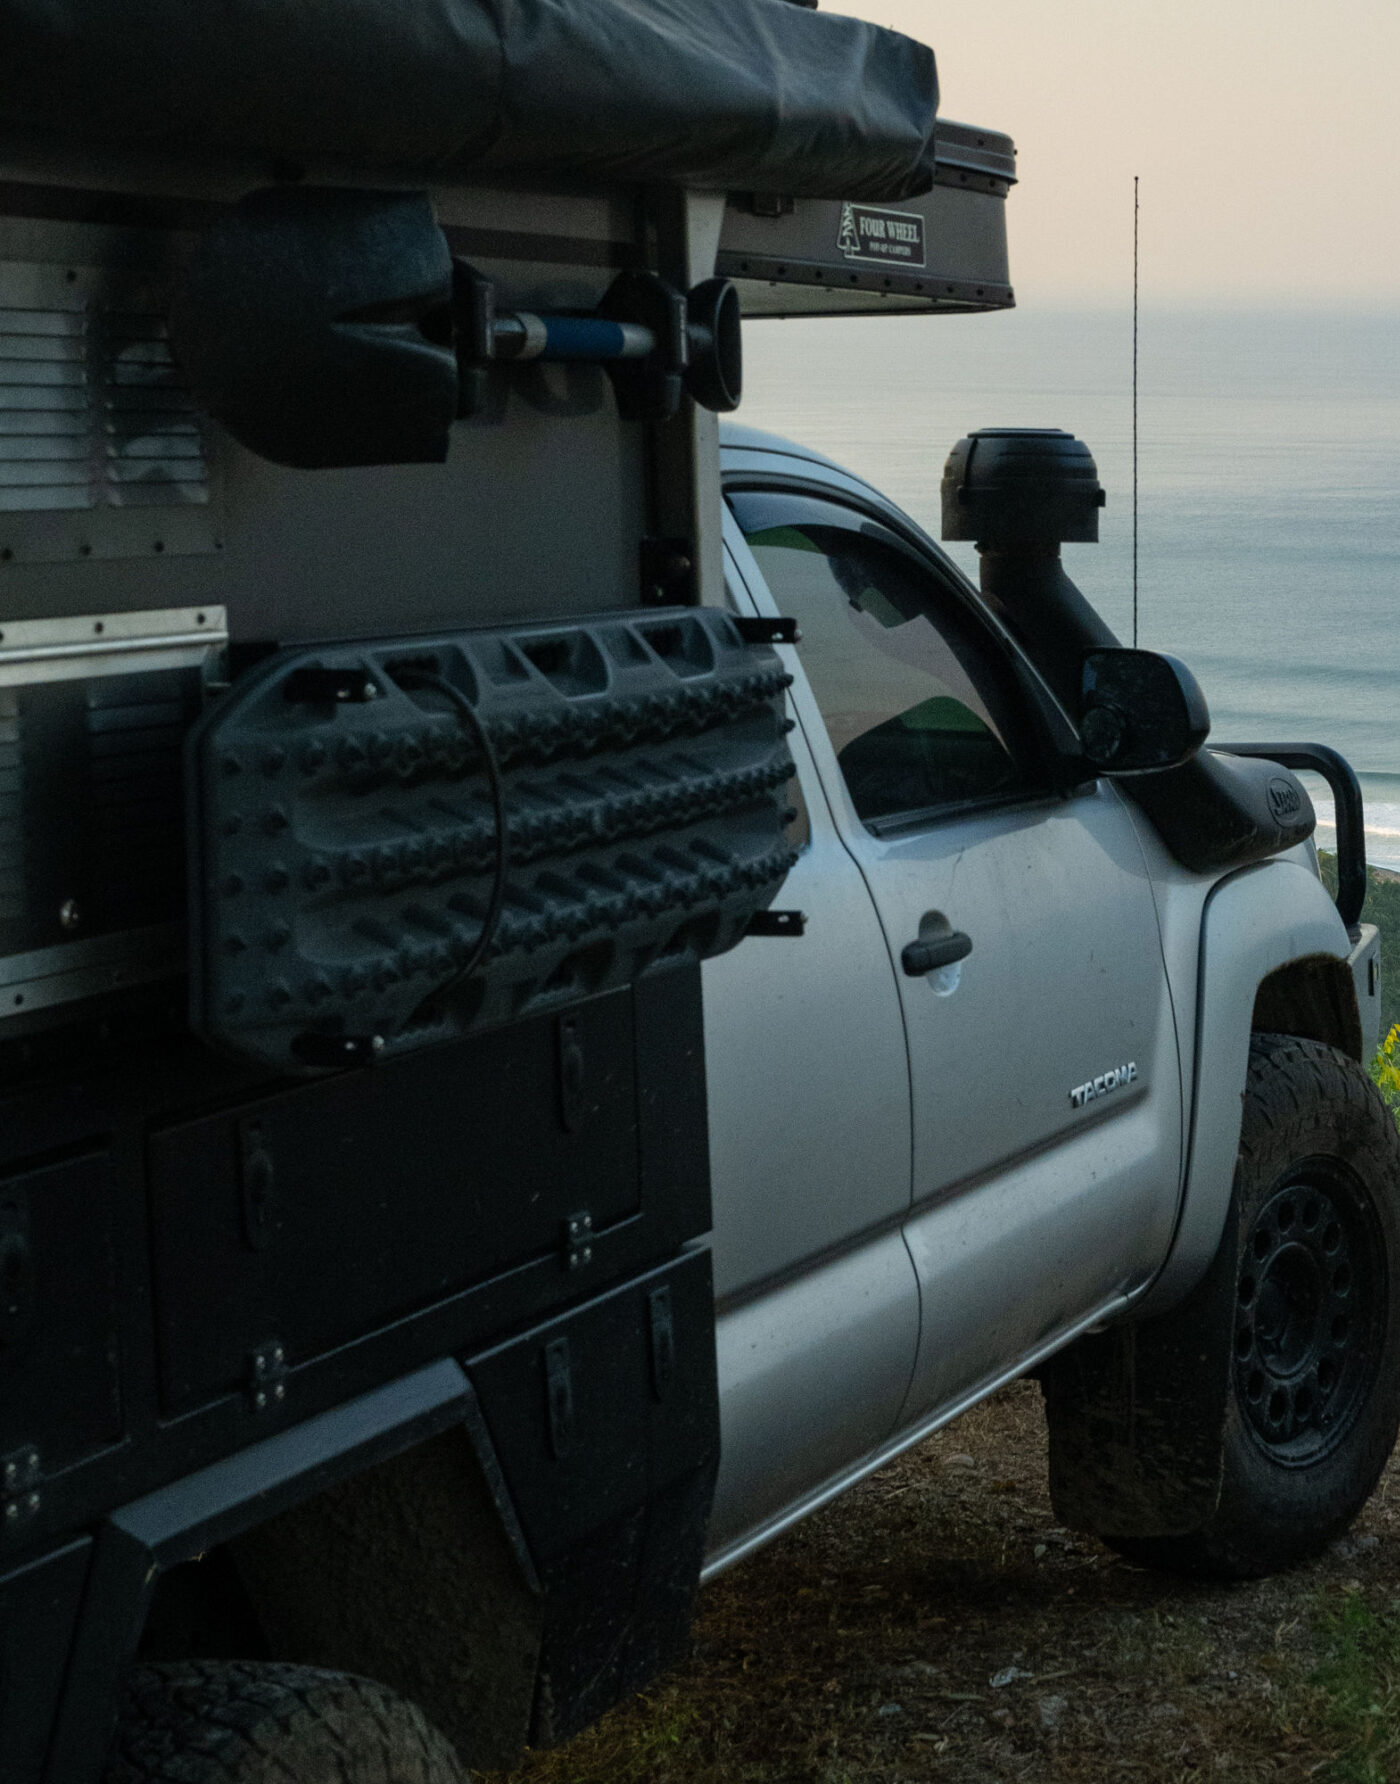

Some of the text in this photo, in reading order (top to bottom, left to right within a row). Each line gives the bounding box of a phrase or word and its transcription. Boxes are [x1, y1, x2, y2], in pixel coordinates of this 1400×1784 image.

[860, 216, 919, 243] FOUR WHEEL
[1070, 1062, 1137, 1106] TACOMA
